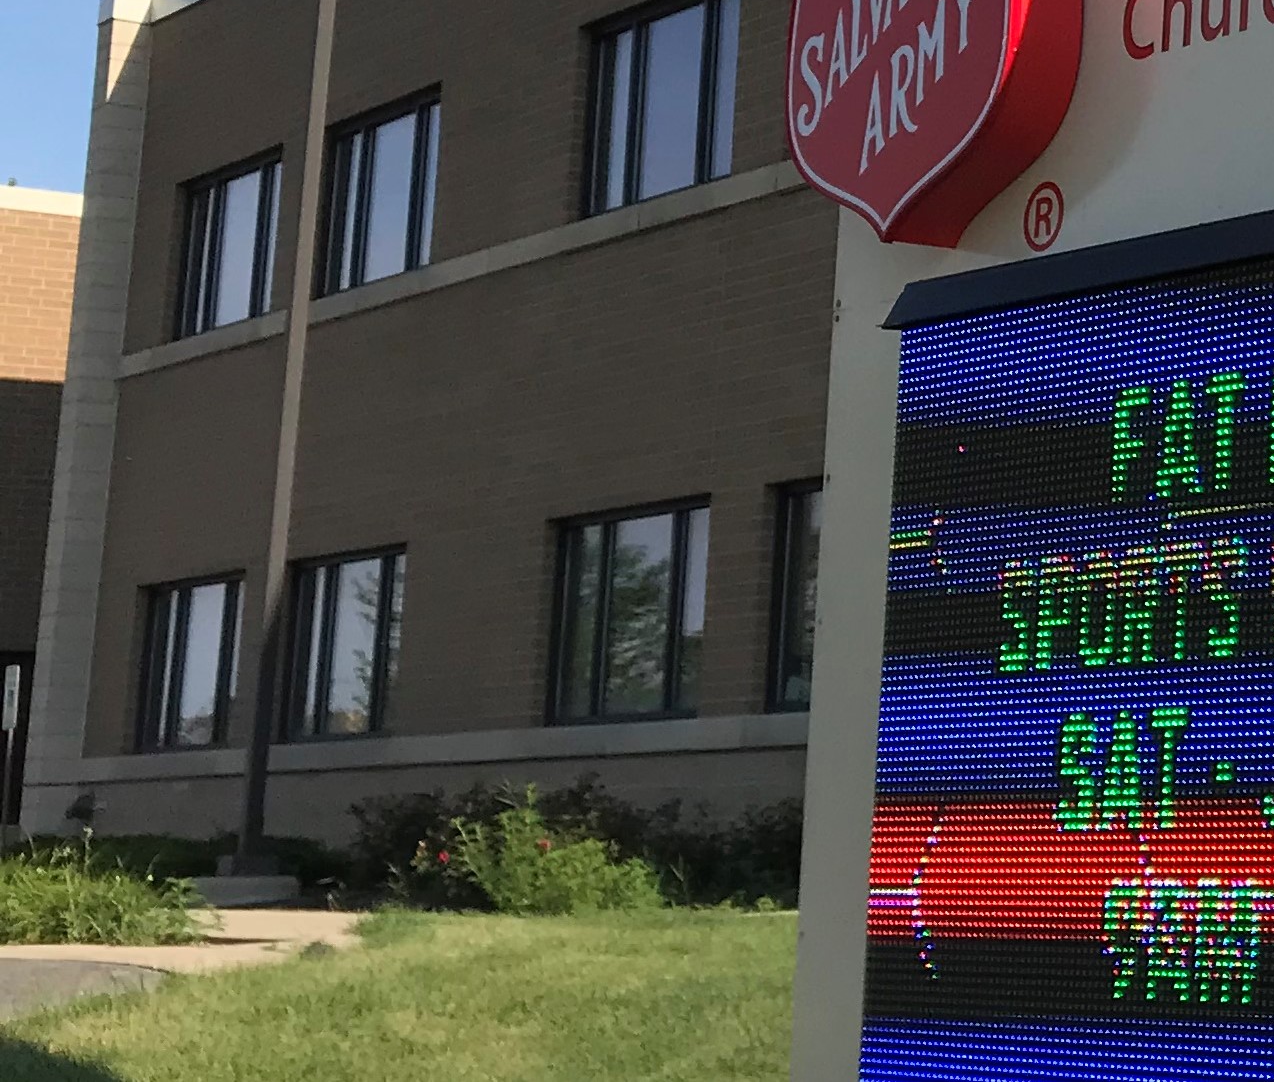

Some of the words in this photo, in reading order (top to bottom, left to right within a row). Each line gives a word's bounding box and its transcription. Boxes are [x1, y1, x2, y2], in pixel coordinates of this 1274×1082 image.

[1111, 372, 1246, 503] FAT
[999, 535, 1248, 673] SPORTS
[1056, 706, 1191, 831] SAT
[1104, 878, 1260, 1004] 9AM
